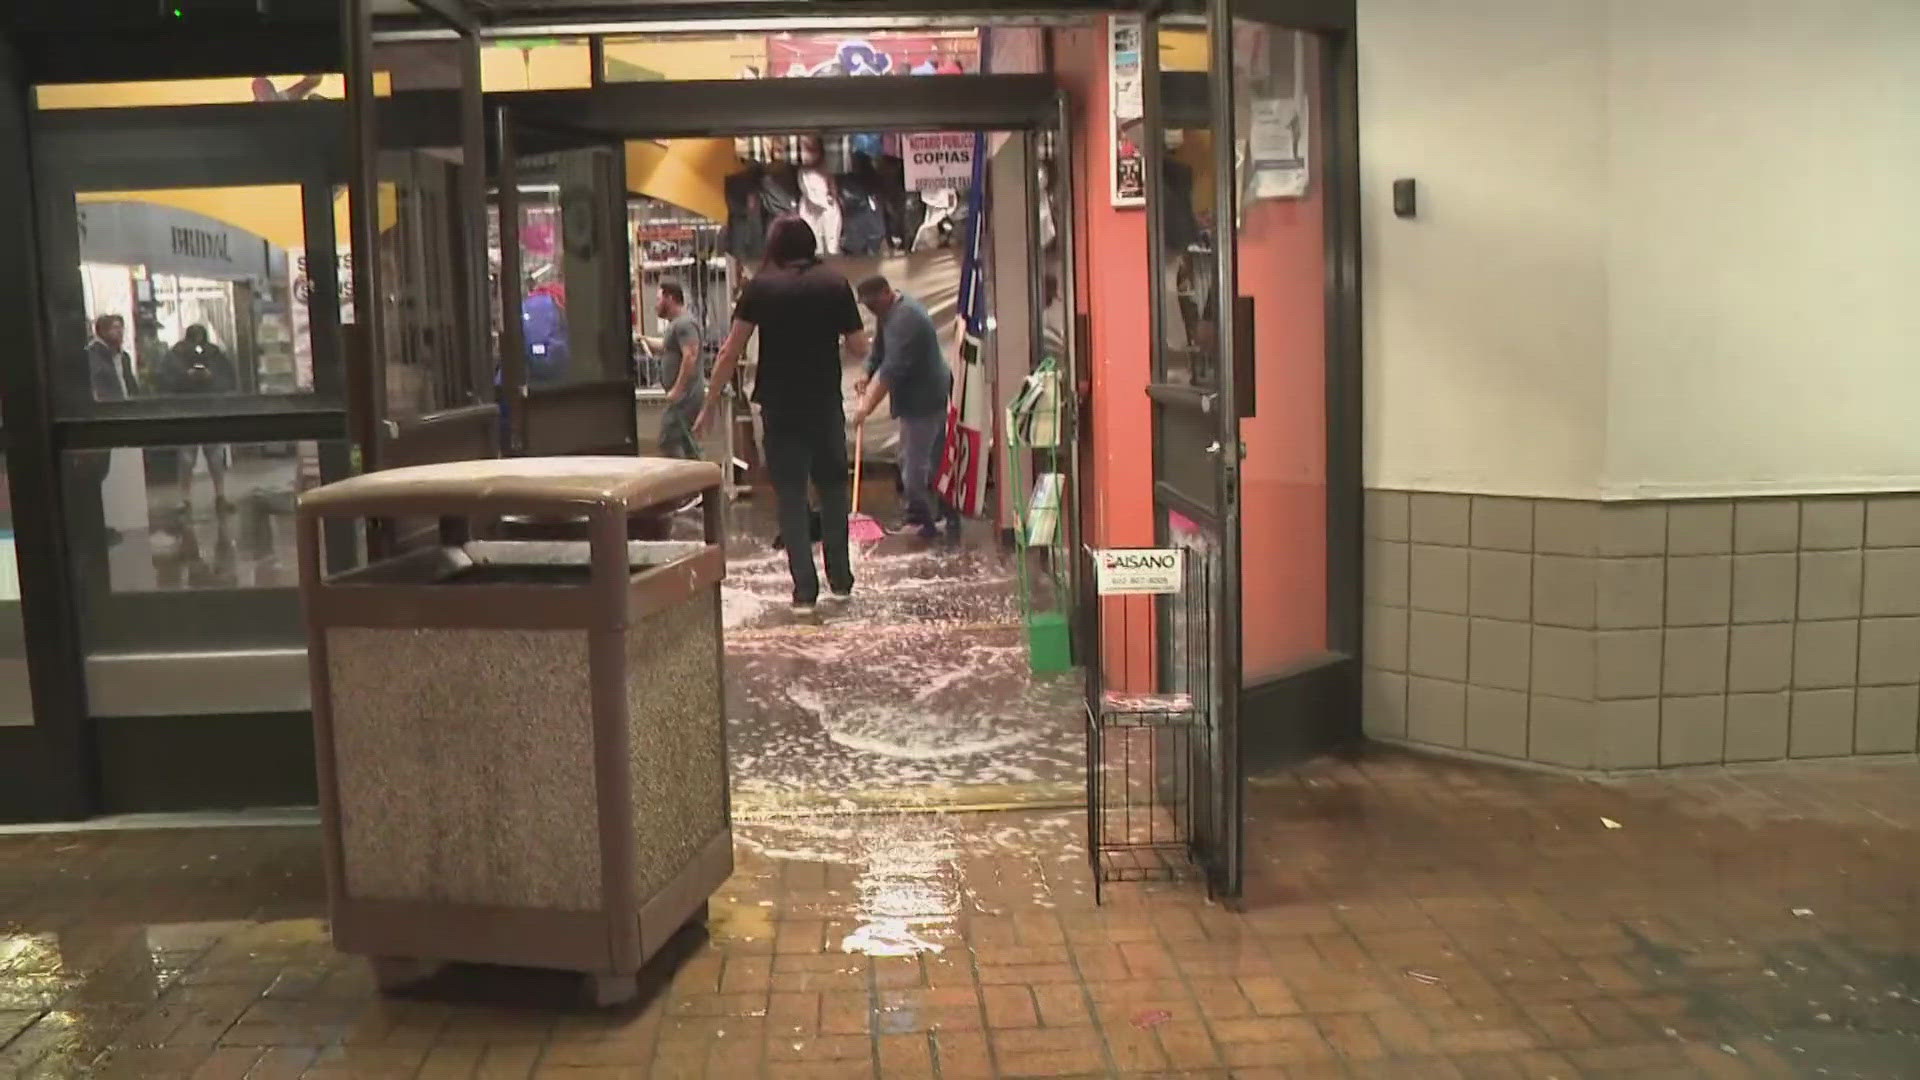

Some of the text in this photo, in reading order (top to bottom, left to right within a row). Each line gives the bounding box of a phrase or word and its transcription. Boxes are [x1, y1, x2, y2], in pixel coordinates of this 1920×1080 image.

[913, 150, 970, 165] COPIAS
[939, 165, 945, 177] Y
[171, 226, 232, 262] BRIDAL
